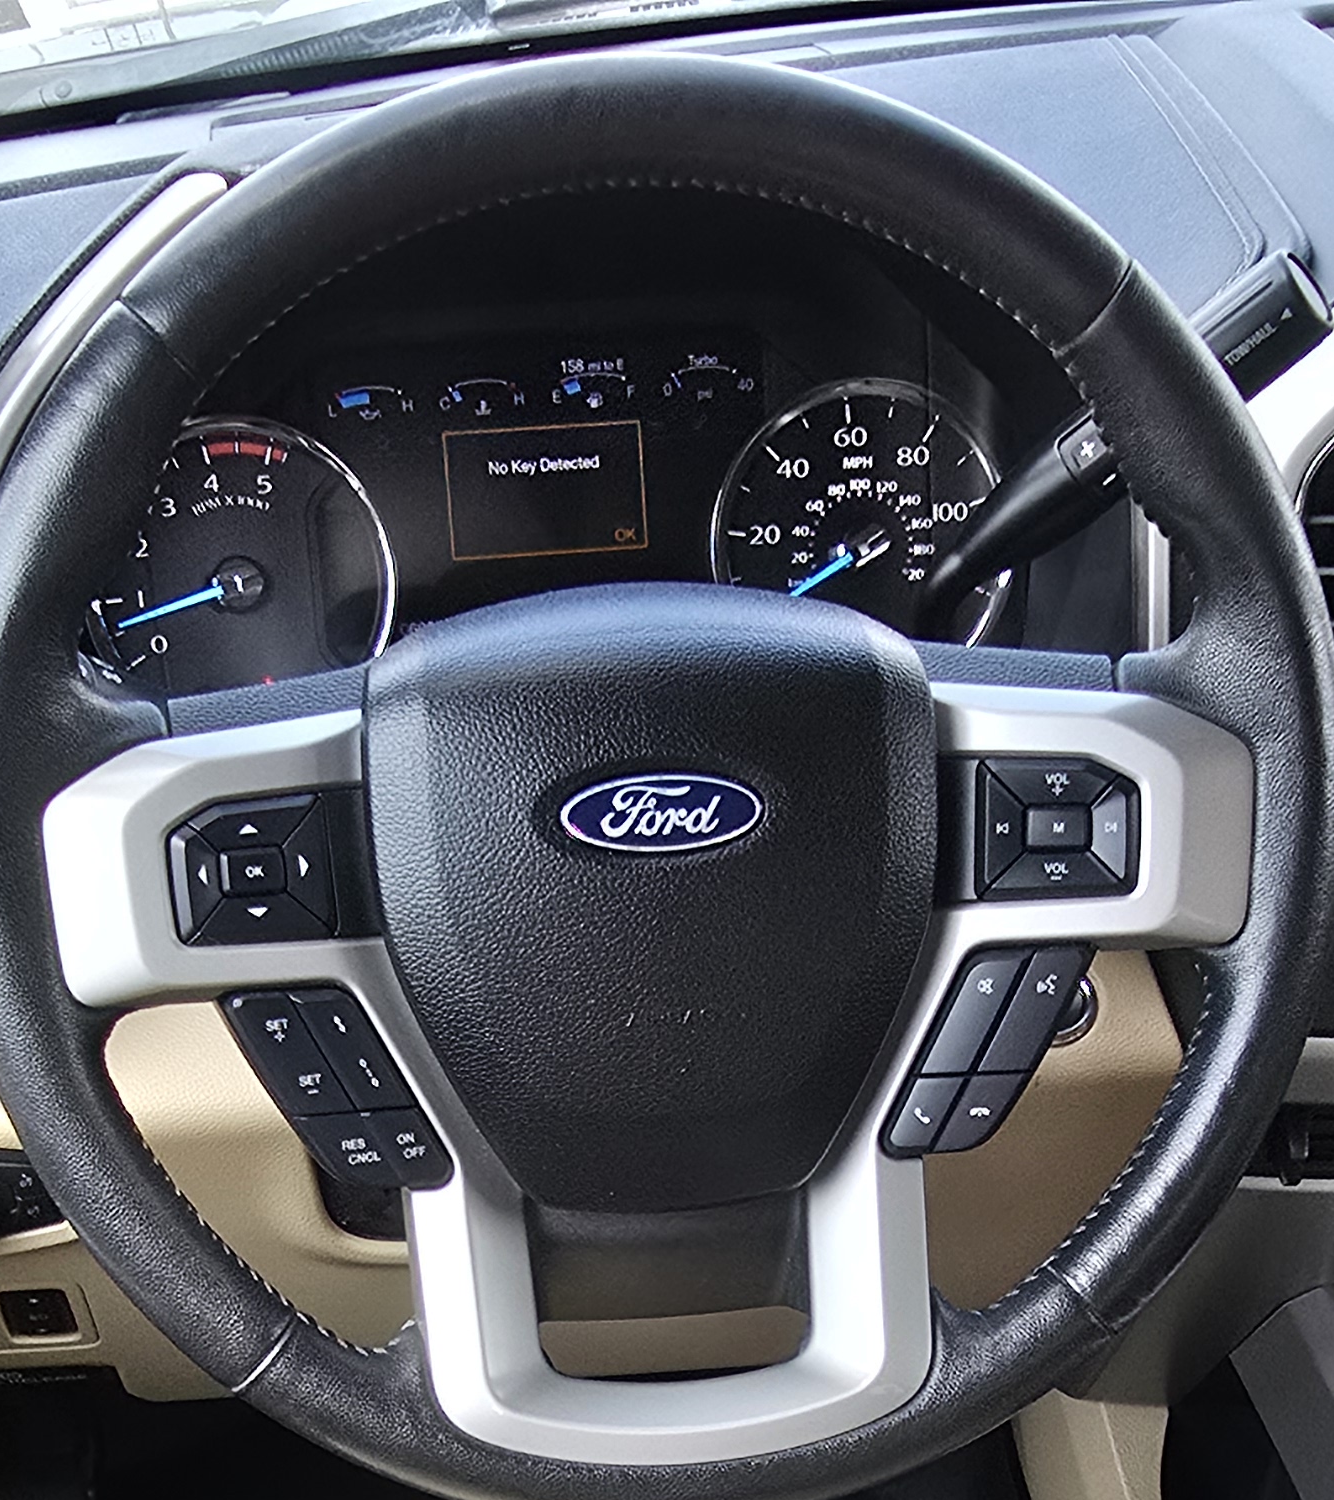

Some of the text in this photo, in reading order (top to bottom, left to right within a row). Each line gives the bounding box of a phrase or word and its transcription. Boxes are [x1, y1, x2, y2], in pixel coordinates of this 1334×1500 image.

[688, 354, 718, 368] Turbo
[737, 378, 754, 392] 40
[439, 396, 451, 411] C
[513, 393, 525, 406] H
[552, 389, 562, 404] E
[329, 403, 338, 418] L
[401, 399, 414, 412] H
[833, 426, 868, 448] 60
[842, 456, 874, 470] MPH
[896, 445, 930, 467] 80
[488, 455, 601, 477] No Key Detected
[776, 457, 810, 479] 40
[203, 473, 220, 493] 4
[256, 473, 273, 495] 5
[827, 483, 847, 498] 80
[849, 477, 872, 491] 100
[875, 481, 898, 494] 120
[160, 497, 178, 518] 3
[804, 499, 824, 513] 60
[898, 494, 921, 507] 140
[932, 502, 969, 523] 100
[791, 525, 810, 537] 40
[911, 518, 934, 530] 160
[614, 528, 637, 542] OK
[749, 524, 781, 546] 20
[135, 538, 150, 558] 2
[791, 552, 808, 564] 20
[150, 634, 169, 654] 0
[1044, 773, 1070, 785] VOL
[599, 785, 721, 838] Ford
[1053, 822, 1065, 835] M
[245, 866, 265, 878] OK
[1043, 862, 1069, 875] VOL
[265, 1017, 290, 1033] SET
[298, 1073, 322, 1088] SET
[341, 1137, 366, 1151] RES
[396, 1131, 415, 1145] ON
[348, 1151, 382, 1166] CNCL
[402, 1145, 427, 1160] OFF
